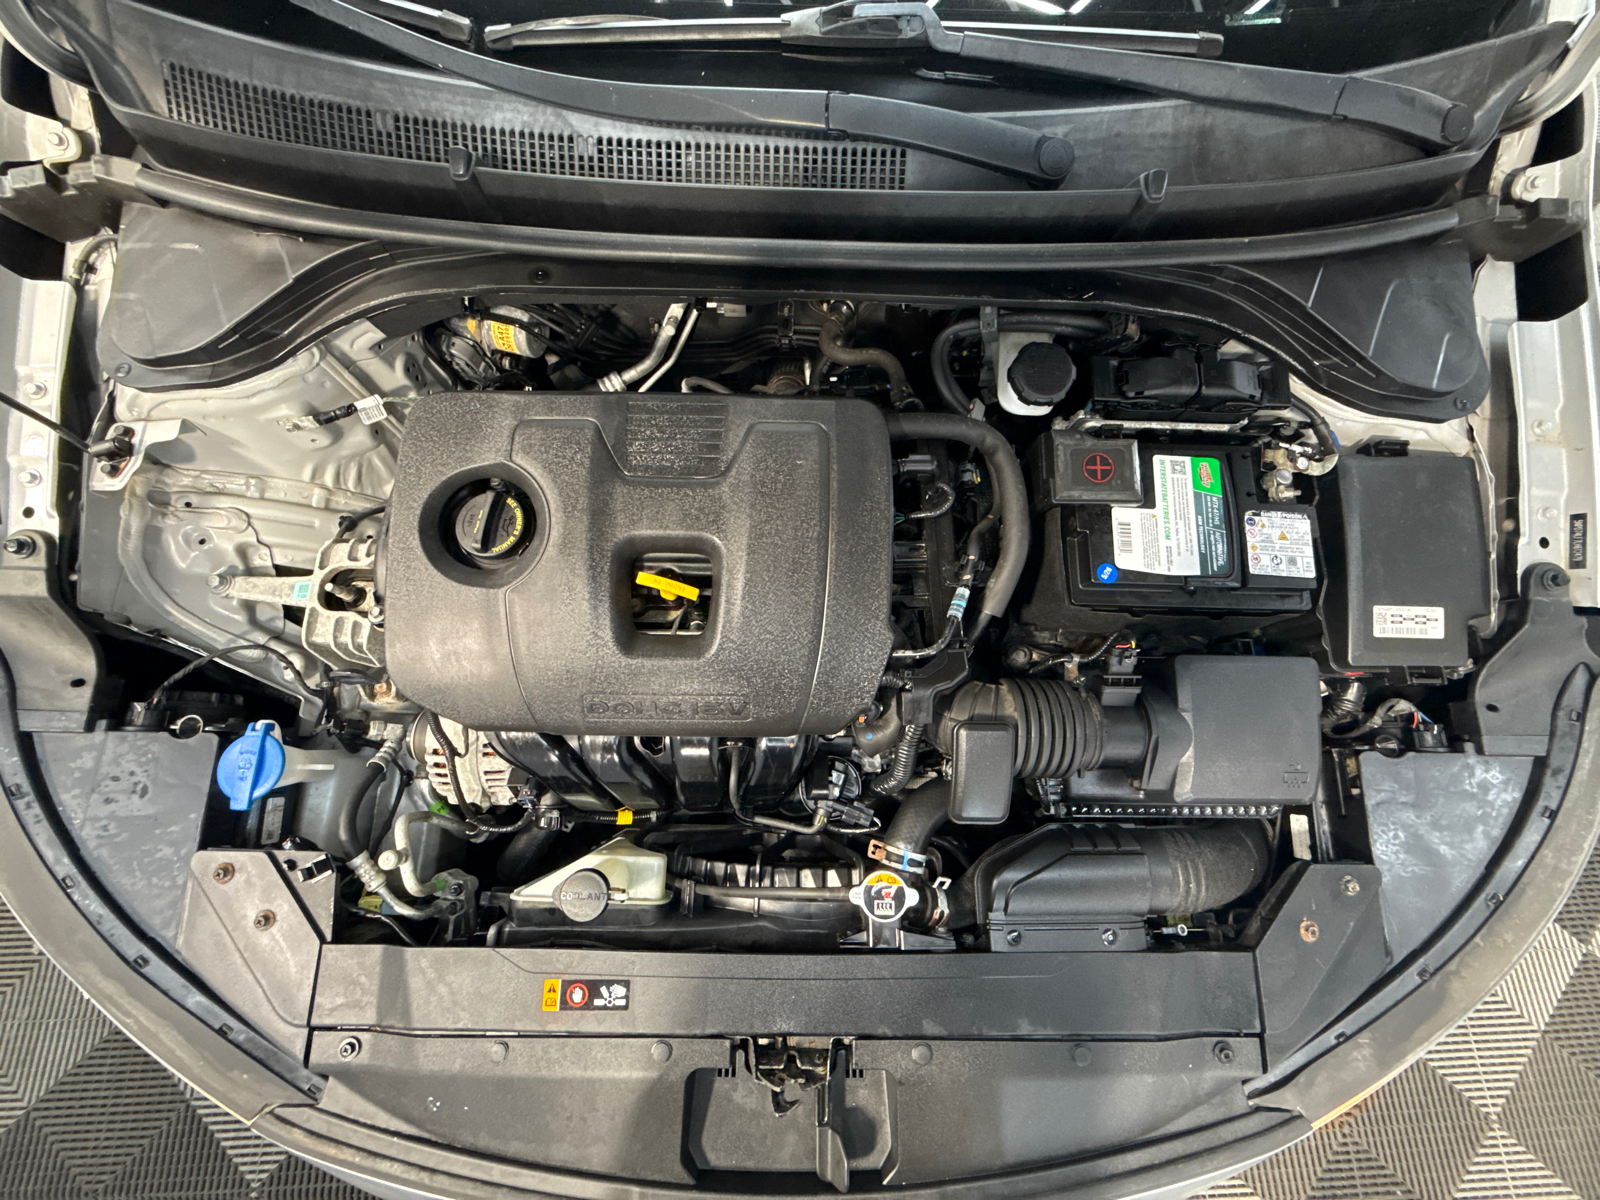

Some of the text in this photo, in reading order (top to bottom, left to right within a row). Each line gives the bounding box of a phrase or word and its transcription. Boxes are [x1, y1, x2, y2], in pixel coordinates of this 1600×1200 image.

[1159, 459, 1171, 541] INTERSTATEBATTERIES.COM
[491, 497, 523, 553] SEE OWNER'S MANUAL
[586, 701, 749, 716] DOHC 16V
[560, 891, 608, 901] COOLANT
